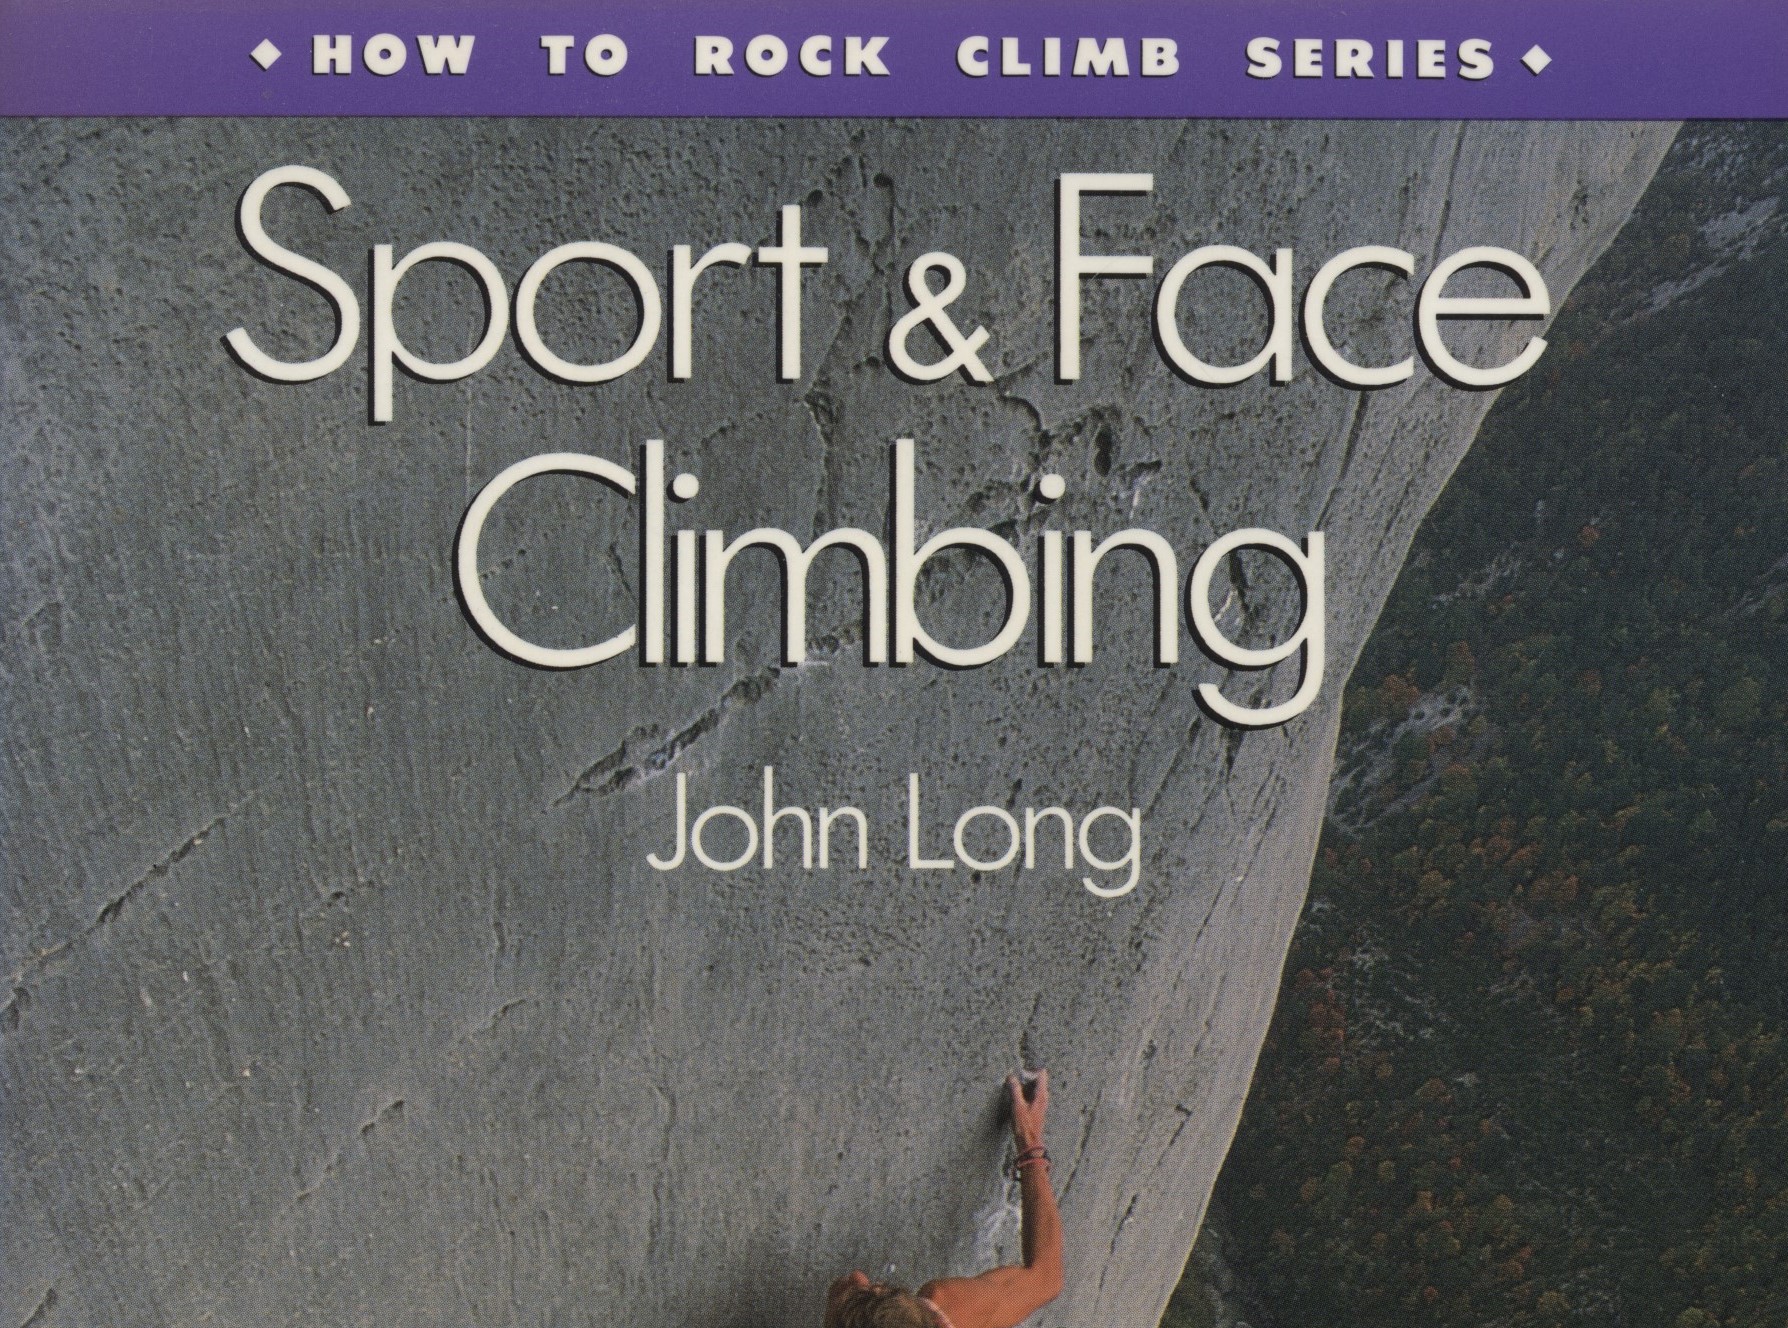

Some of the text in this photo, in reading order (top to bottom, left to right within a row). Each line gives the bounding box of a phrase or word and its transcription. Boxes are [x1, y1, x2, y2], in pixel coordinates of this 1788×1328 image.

[312, 34, 1495, 79] HOW TO ROCK CLIMB SERIES
[225, 164, 1552, 423] Sport & Face
[456, 437, 1326, 727] Climbing
[646, 765, 1142, 898] John Long
